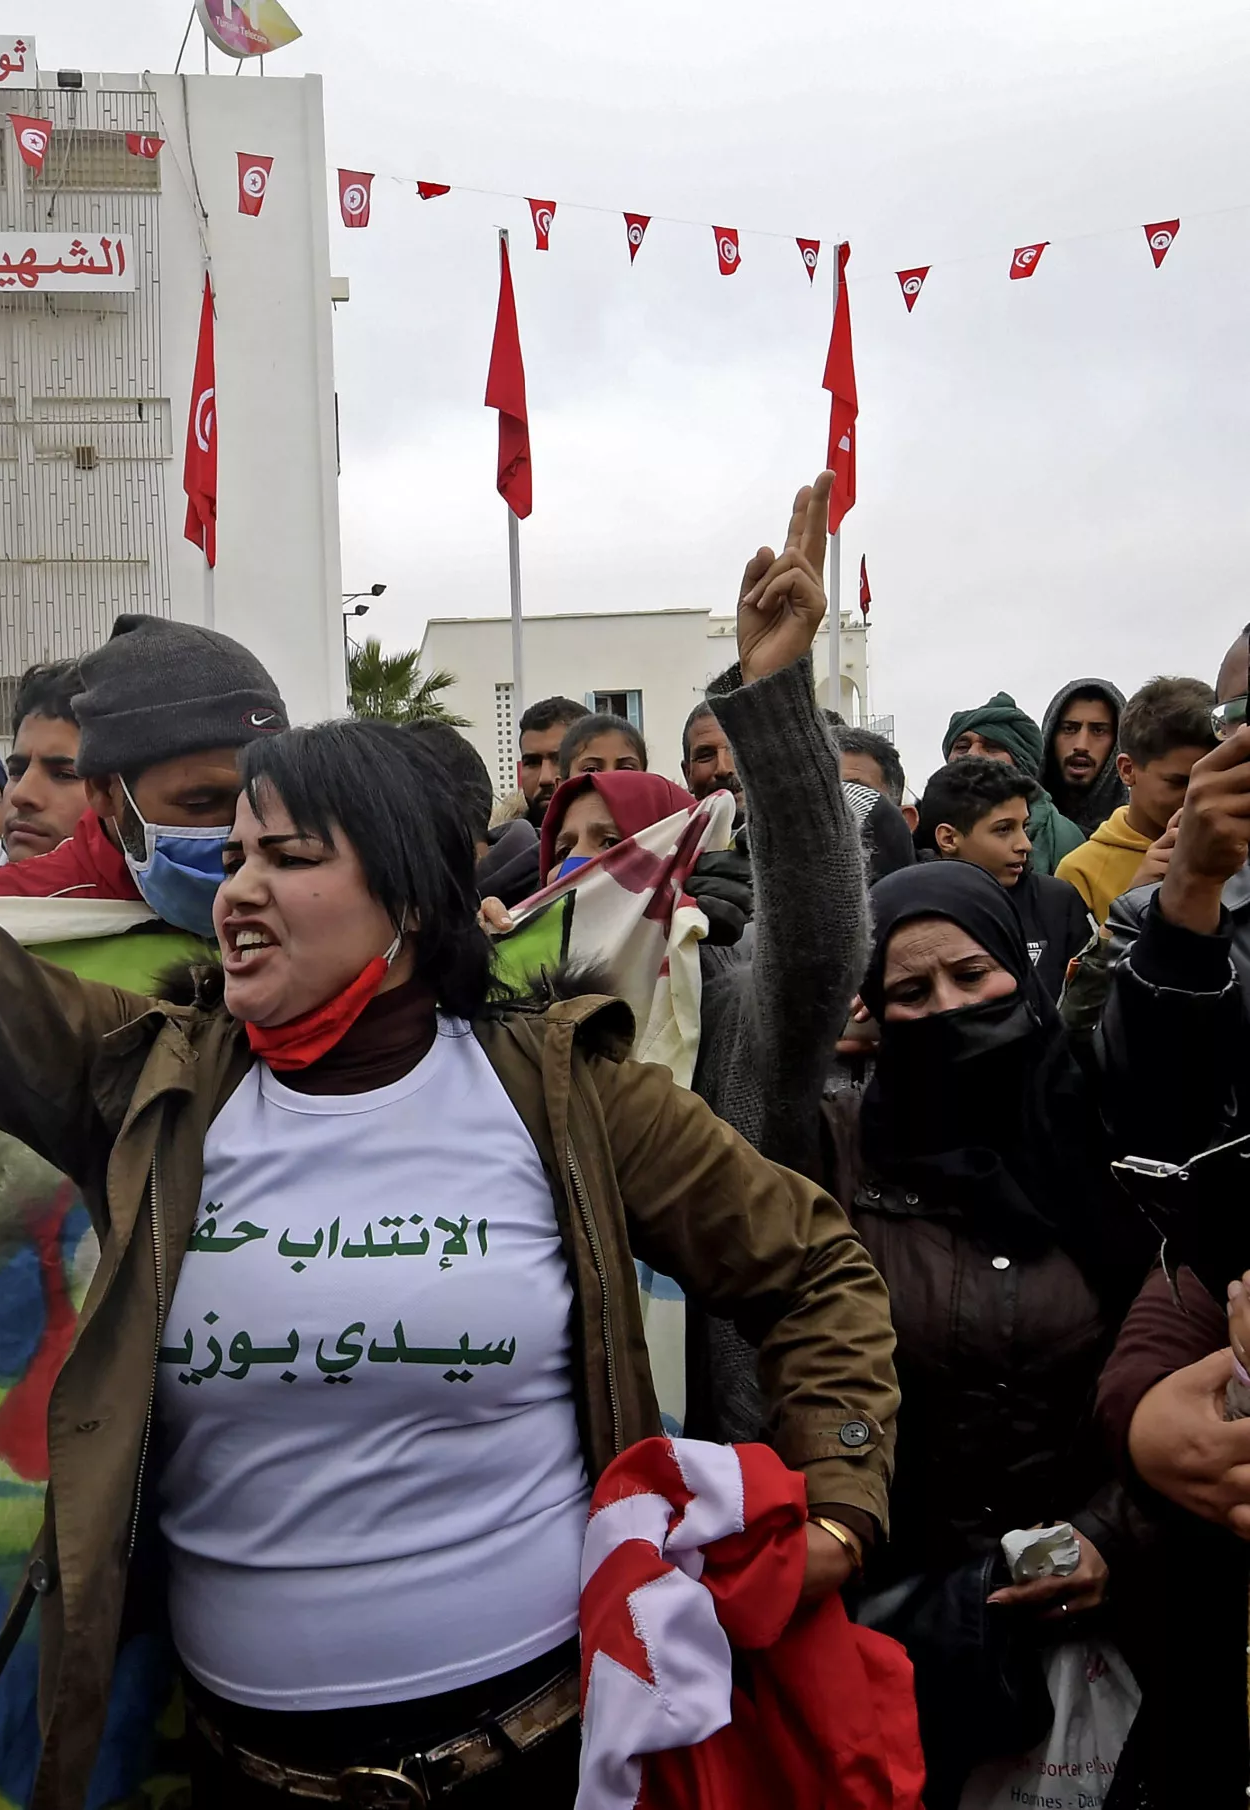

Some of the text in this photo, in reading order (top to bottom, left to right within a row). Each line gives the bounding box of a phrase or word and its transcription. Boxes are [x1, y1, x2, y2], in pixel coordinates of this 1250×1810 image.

[240, 26, 268, 44] Telecom
[185, 1200, 489, 1274] الإنتداب حق
[156, 1310, 516, 1385] سيدي بوزي
